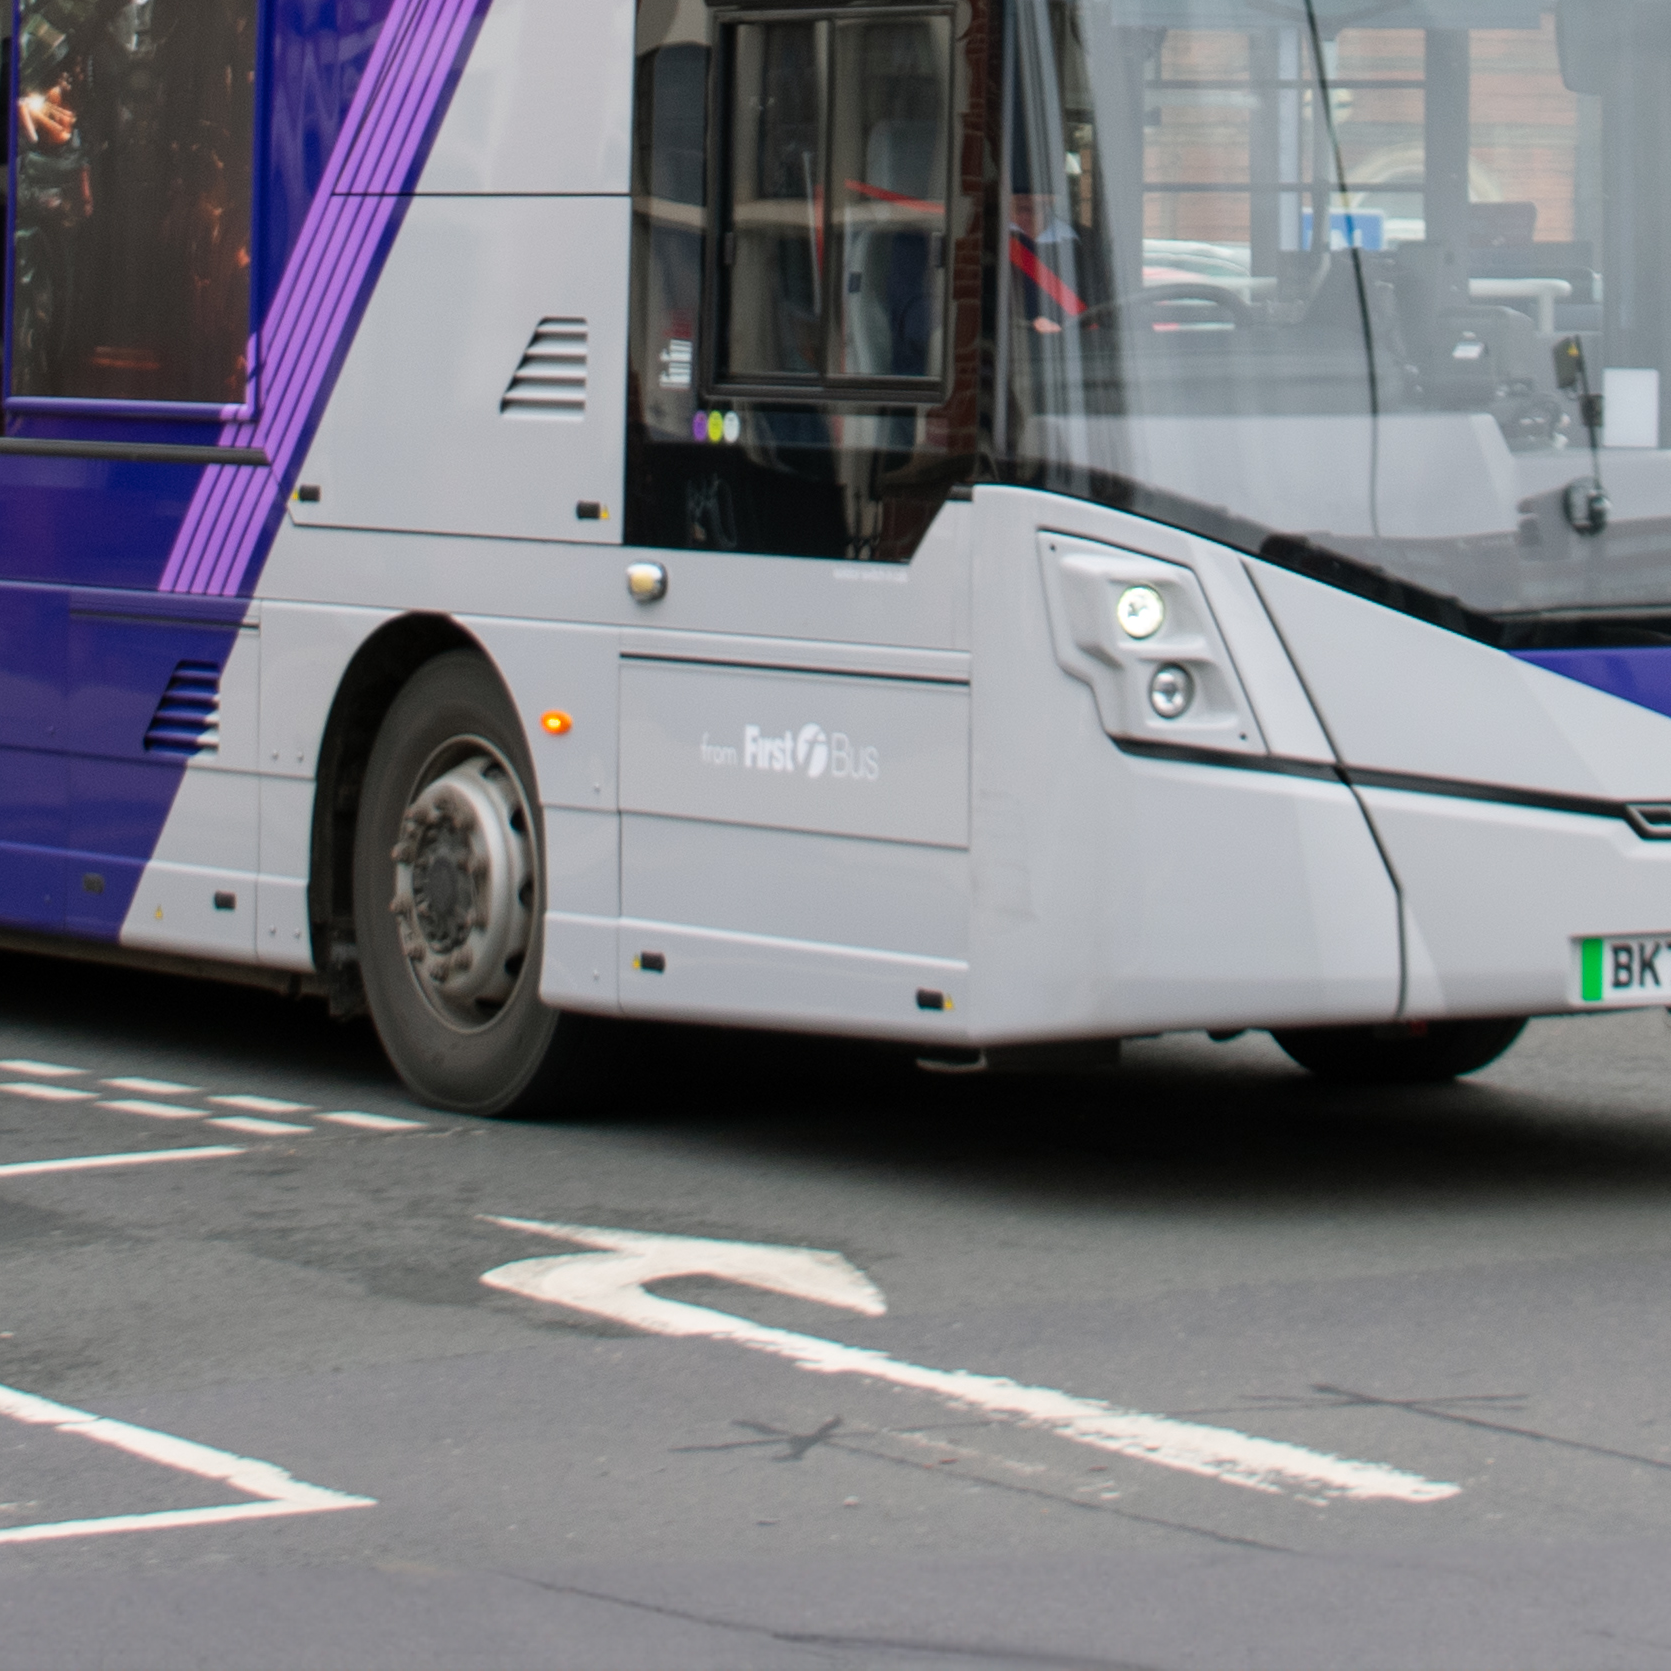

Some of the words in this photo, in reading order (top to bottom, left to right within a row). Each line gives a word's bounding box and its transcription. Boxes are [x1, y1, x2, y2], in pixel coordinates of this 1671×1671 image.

[700, 732, 738, 767] from
[743, 724, 796, 774] First
[831, 732, 880, 780] Bus
